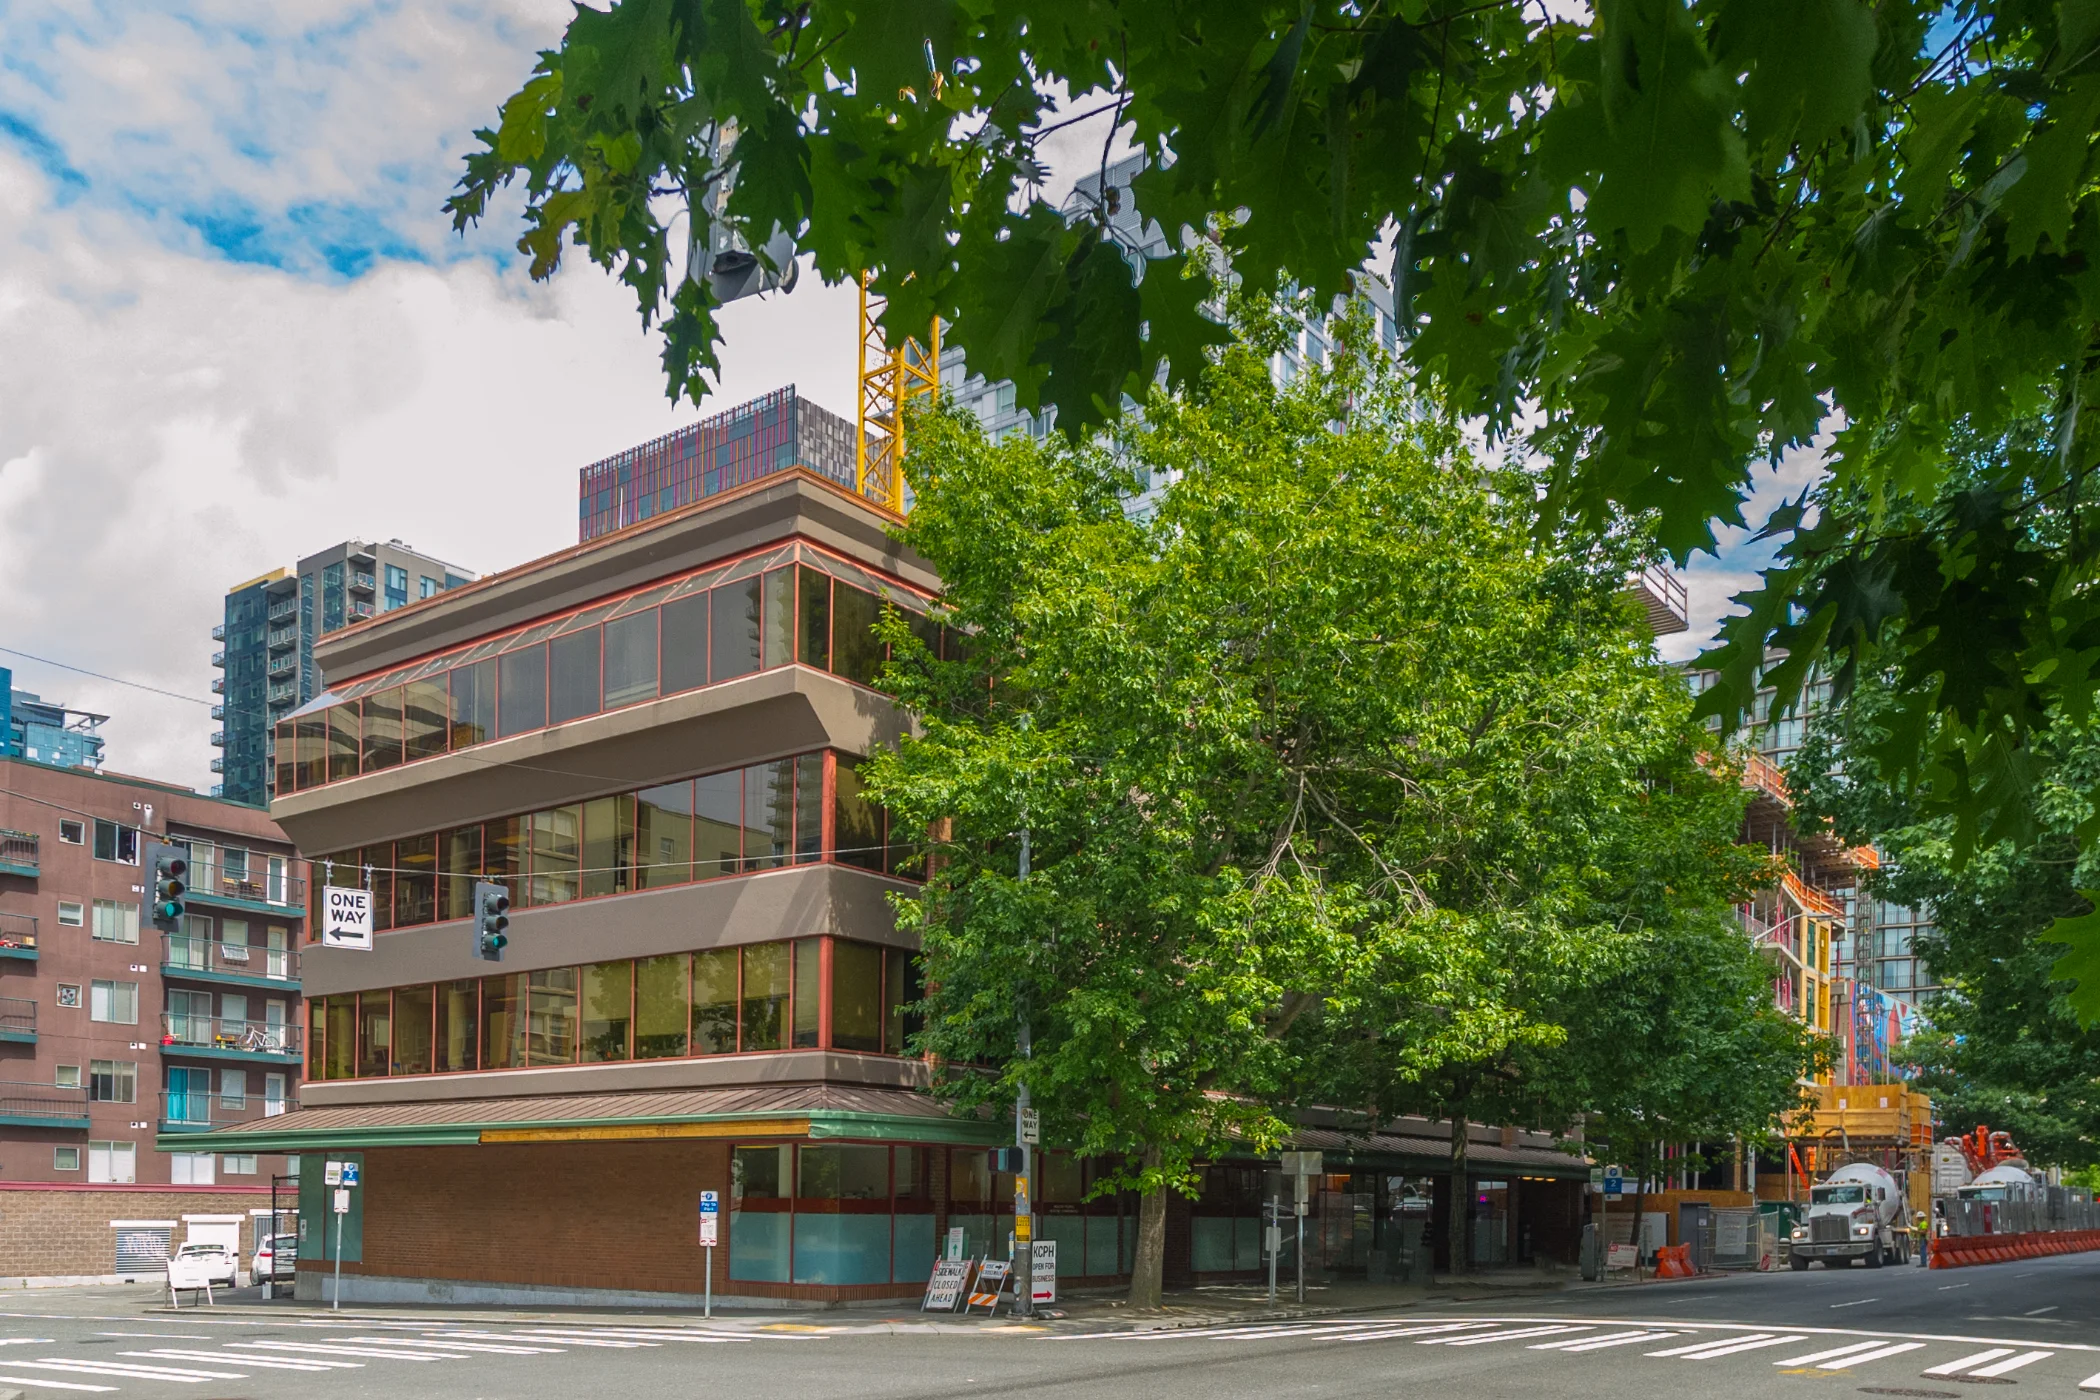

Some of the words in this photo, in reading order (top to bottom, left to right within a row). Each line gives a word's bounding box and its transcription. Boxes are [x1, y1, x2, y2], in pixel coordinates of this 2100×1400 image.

[331, 893, 366, 909] ONE
[331, 909, 367, 924] WAY
[1023, 1108, 1038, 1119] ONE
[1022, 1120, 1037, 1129] WAY
[1033, 1246, 1054, 1258] KCPH
[1032, 1263, 1044, 1271] OPEN
[1045, 1262, 1054, 1270] FOR
[936, 1267, 963, 1277] SIDEWALK
[1032, 1274, 1054, 1283] BUSINESS
[934, 1280, 959, 1290] CLOSED
[931, 1293, 953, 1303] AHEAD
